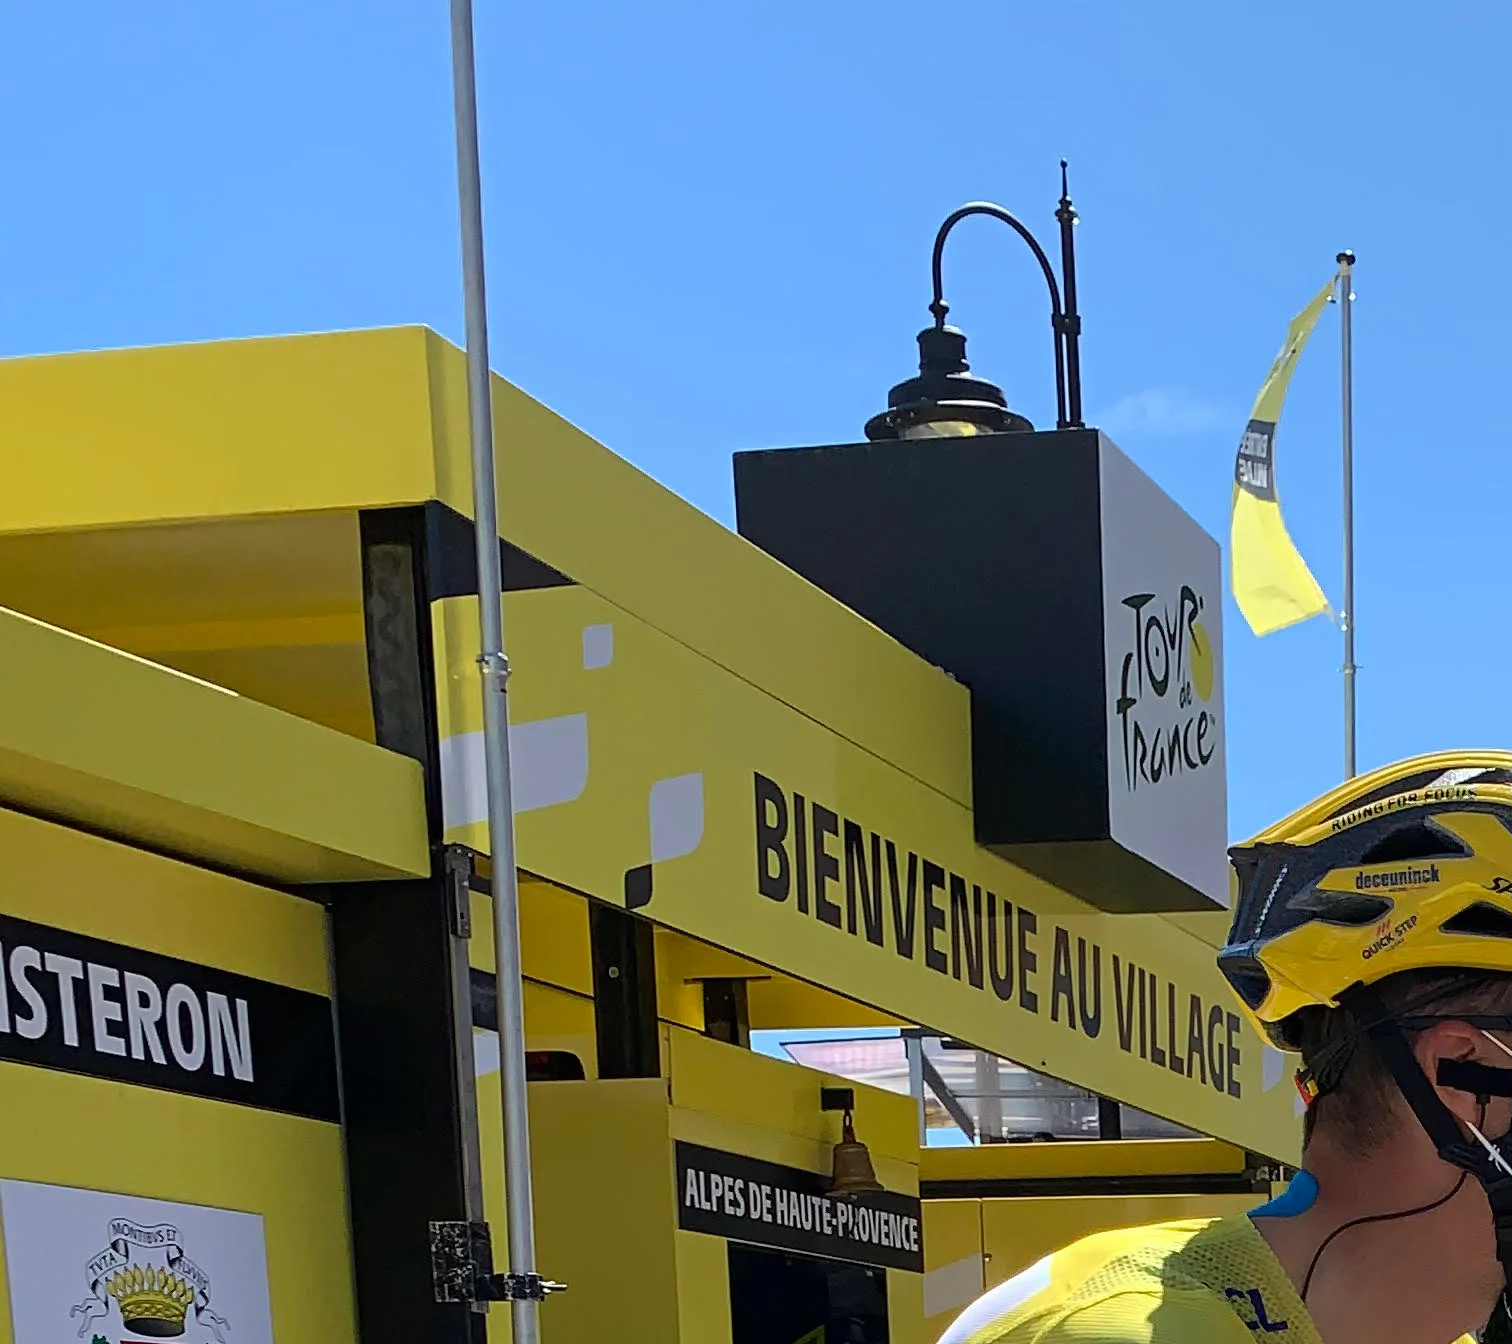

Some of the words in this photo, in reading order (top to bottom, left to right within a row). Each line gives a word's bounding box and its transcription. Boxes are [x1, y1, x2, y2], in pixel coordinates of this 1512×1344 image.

[1355, 864, 1441, 890] deceuninck
[753, 771, 1039, 1014] BIENVENUE
[1050, 926, 1102, 1039] AU
[1112, 954, 1242, 1098] VILLAGE
[685, 1168, 746, 1217] ALPES
[749, 1181, 773, 1223] DE
[775, 1187, 920, 1252] HAUTE-PROVENCE
